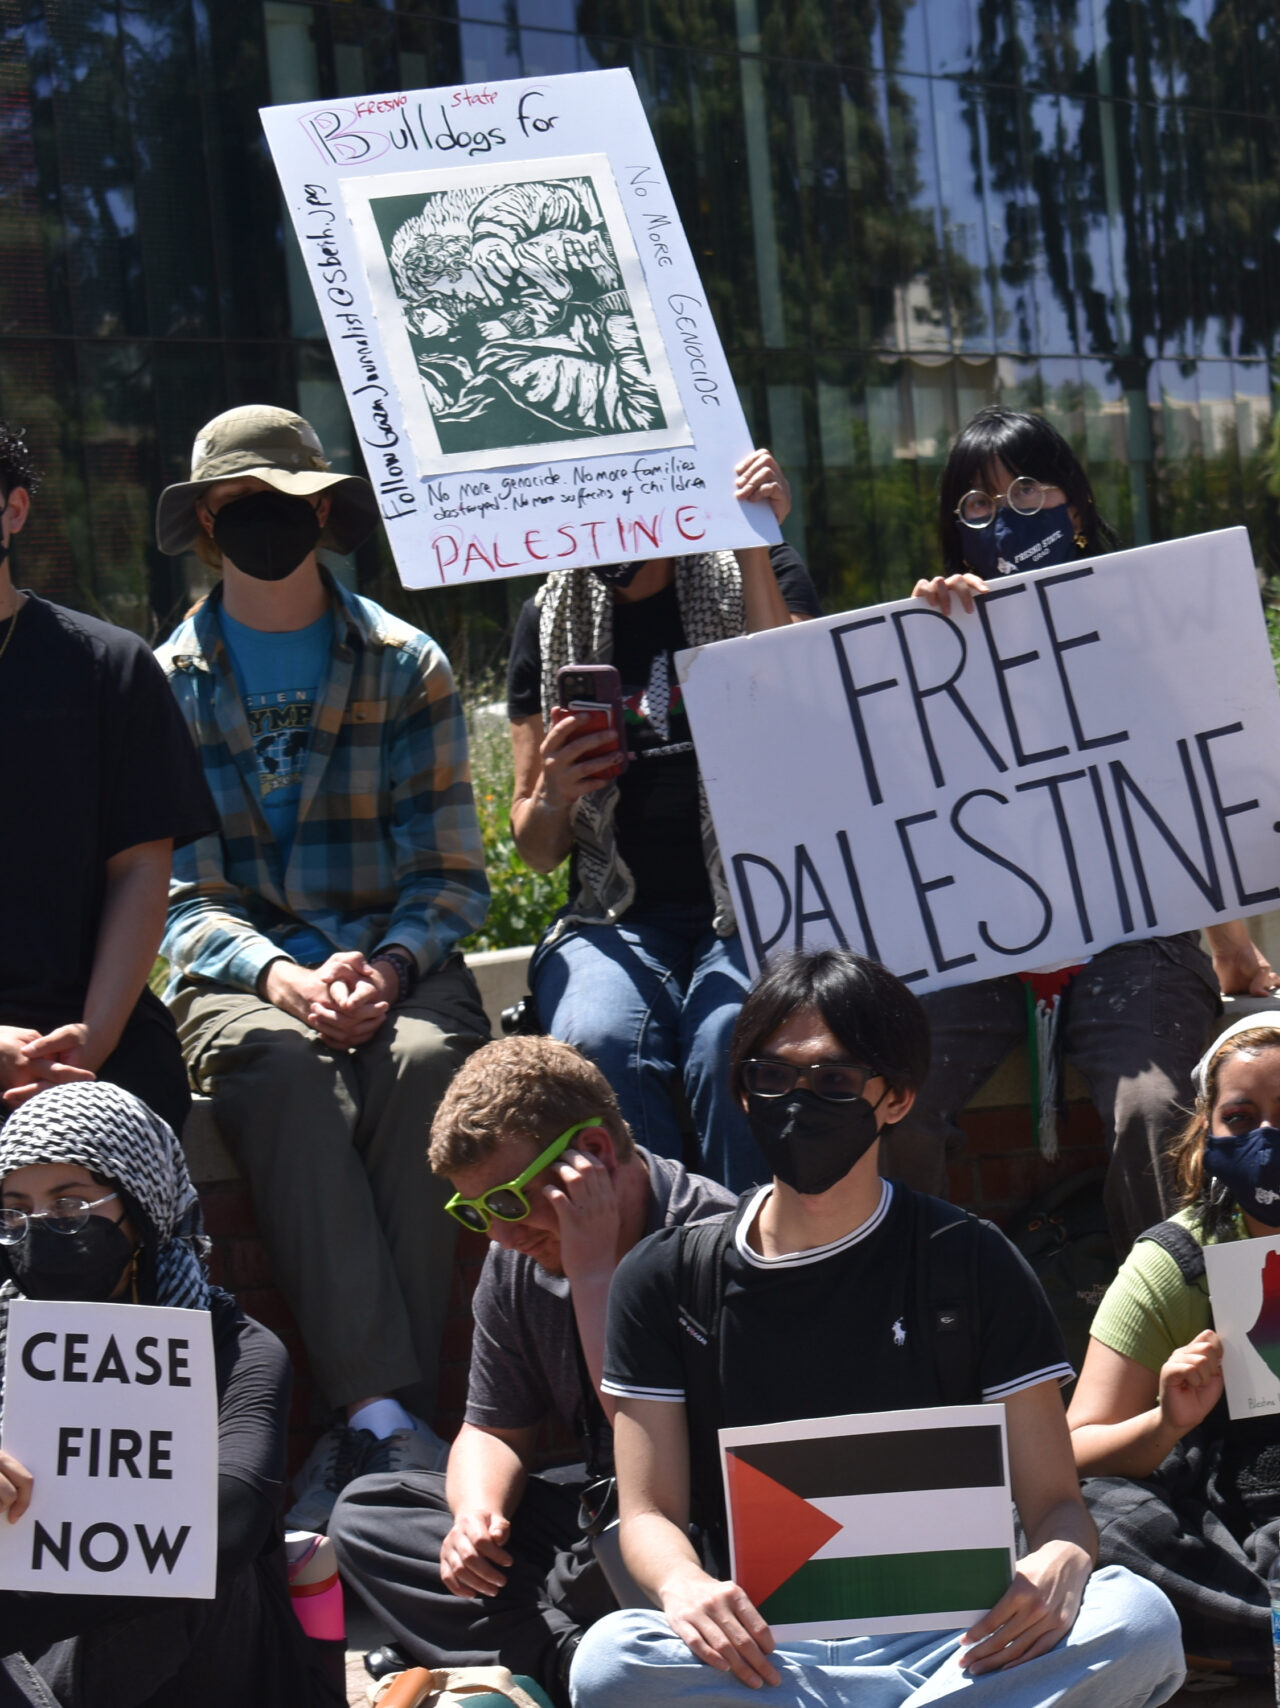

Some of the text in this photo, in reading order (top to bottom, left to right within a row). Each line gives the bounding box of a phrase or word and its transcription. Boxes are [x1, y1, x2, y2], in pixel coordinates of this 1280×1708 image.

[297, 91, 560, 166] Bulldogs for
[625, 165, 661, 197] No
[667, 293, 721, 407] GENOCIDE
[379, 452, 418, 521] Follow
[427, 483, 450, 506] No
[631, 456, 696, 482] families
[431, 505, 707, 584] PALESTINE
[829, 567, 1130, 805] FREE
[21, 1331, 192, 1387] CEASE
[56, 1426, 173, 1480] FIRE
[31, 1519, 192, 1575] NOW
